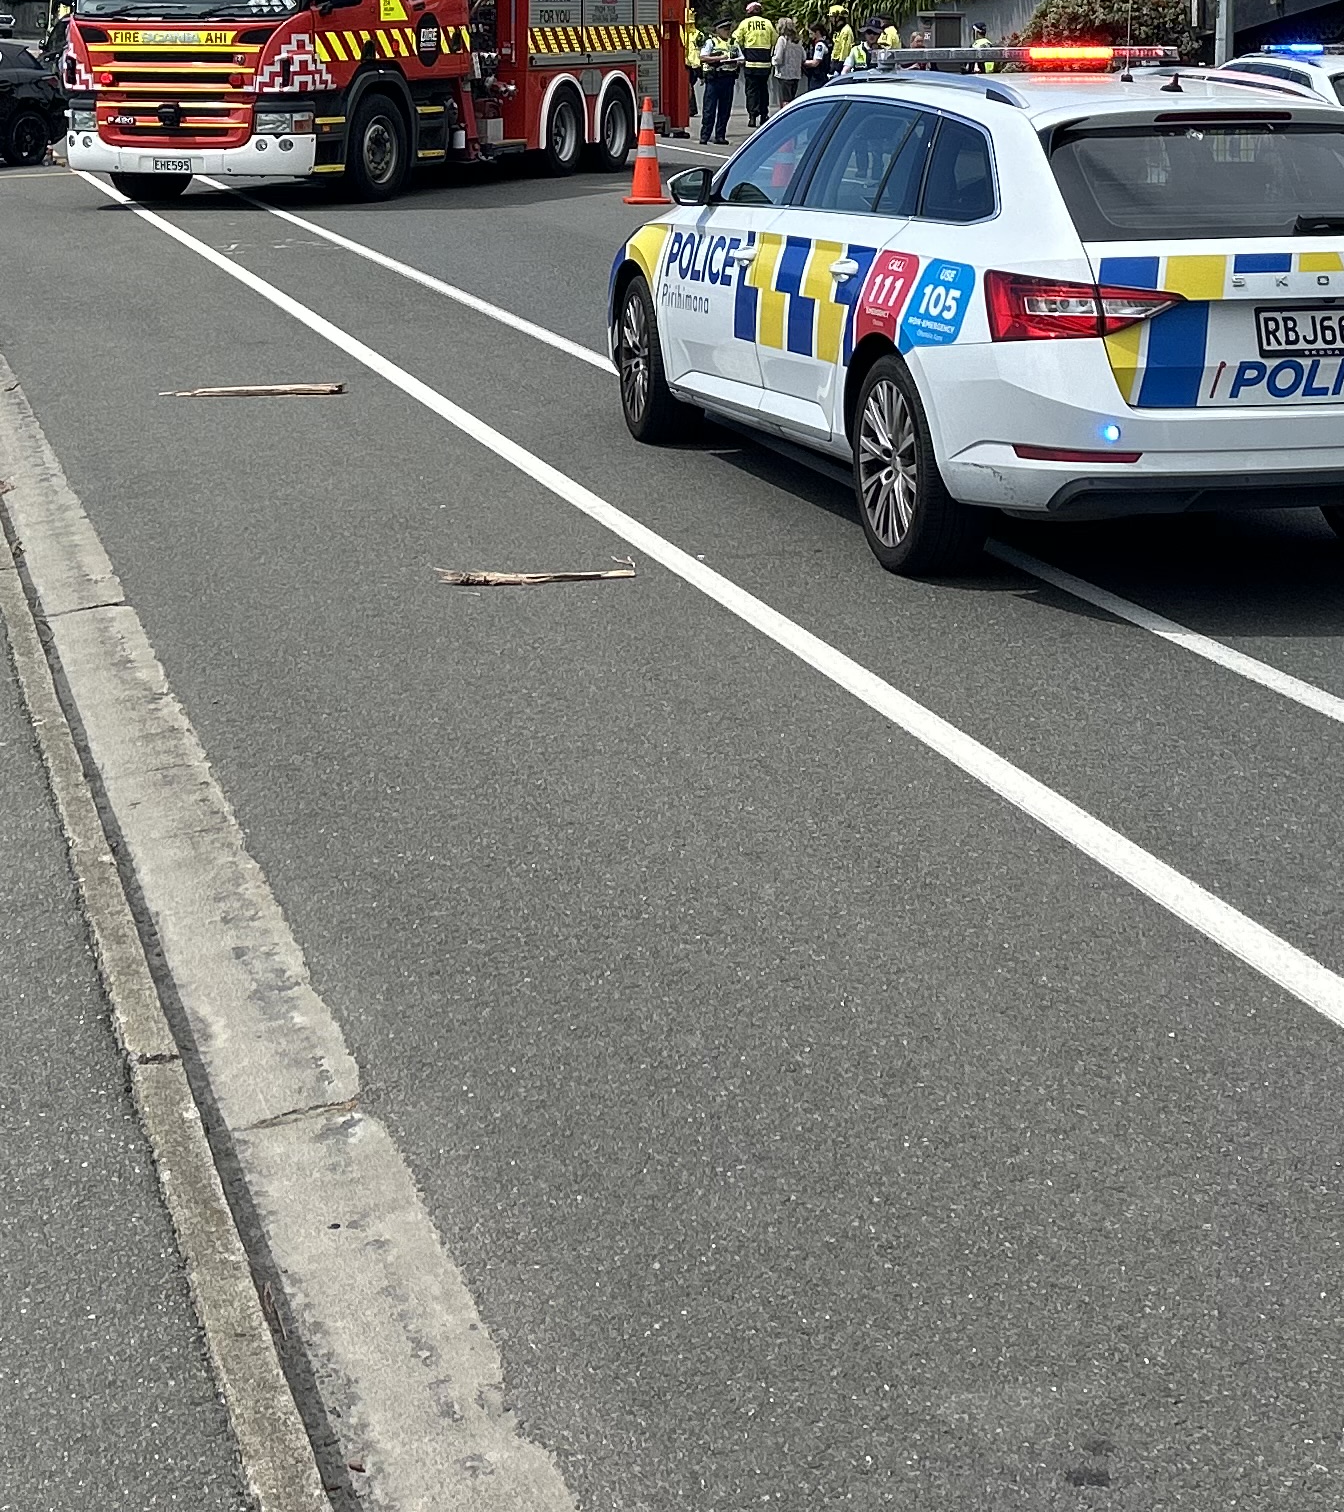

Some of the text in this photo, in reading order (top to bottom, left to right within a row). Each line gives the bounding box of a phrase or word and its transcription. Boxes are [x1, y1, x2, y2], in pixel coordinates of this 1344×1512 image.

[539, 9, 571, 24] FOR YOU
[747, 21, 766, 31] FIRE
[113, 31, 140, 43] FIRE
[204, 32, 228, 44] AHI
[154, 159, 190, 172] EHE595
[664, 231, 742, 287] POLICE
[940, 268, 957, 283] USE
[867, 273, 905, 307] 111
[660, 283, 710, 315] Pirihimana
[918, 283, 962, 321] 105
